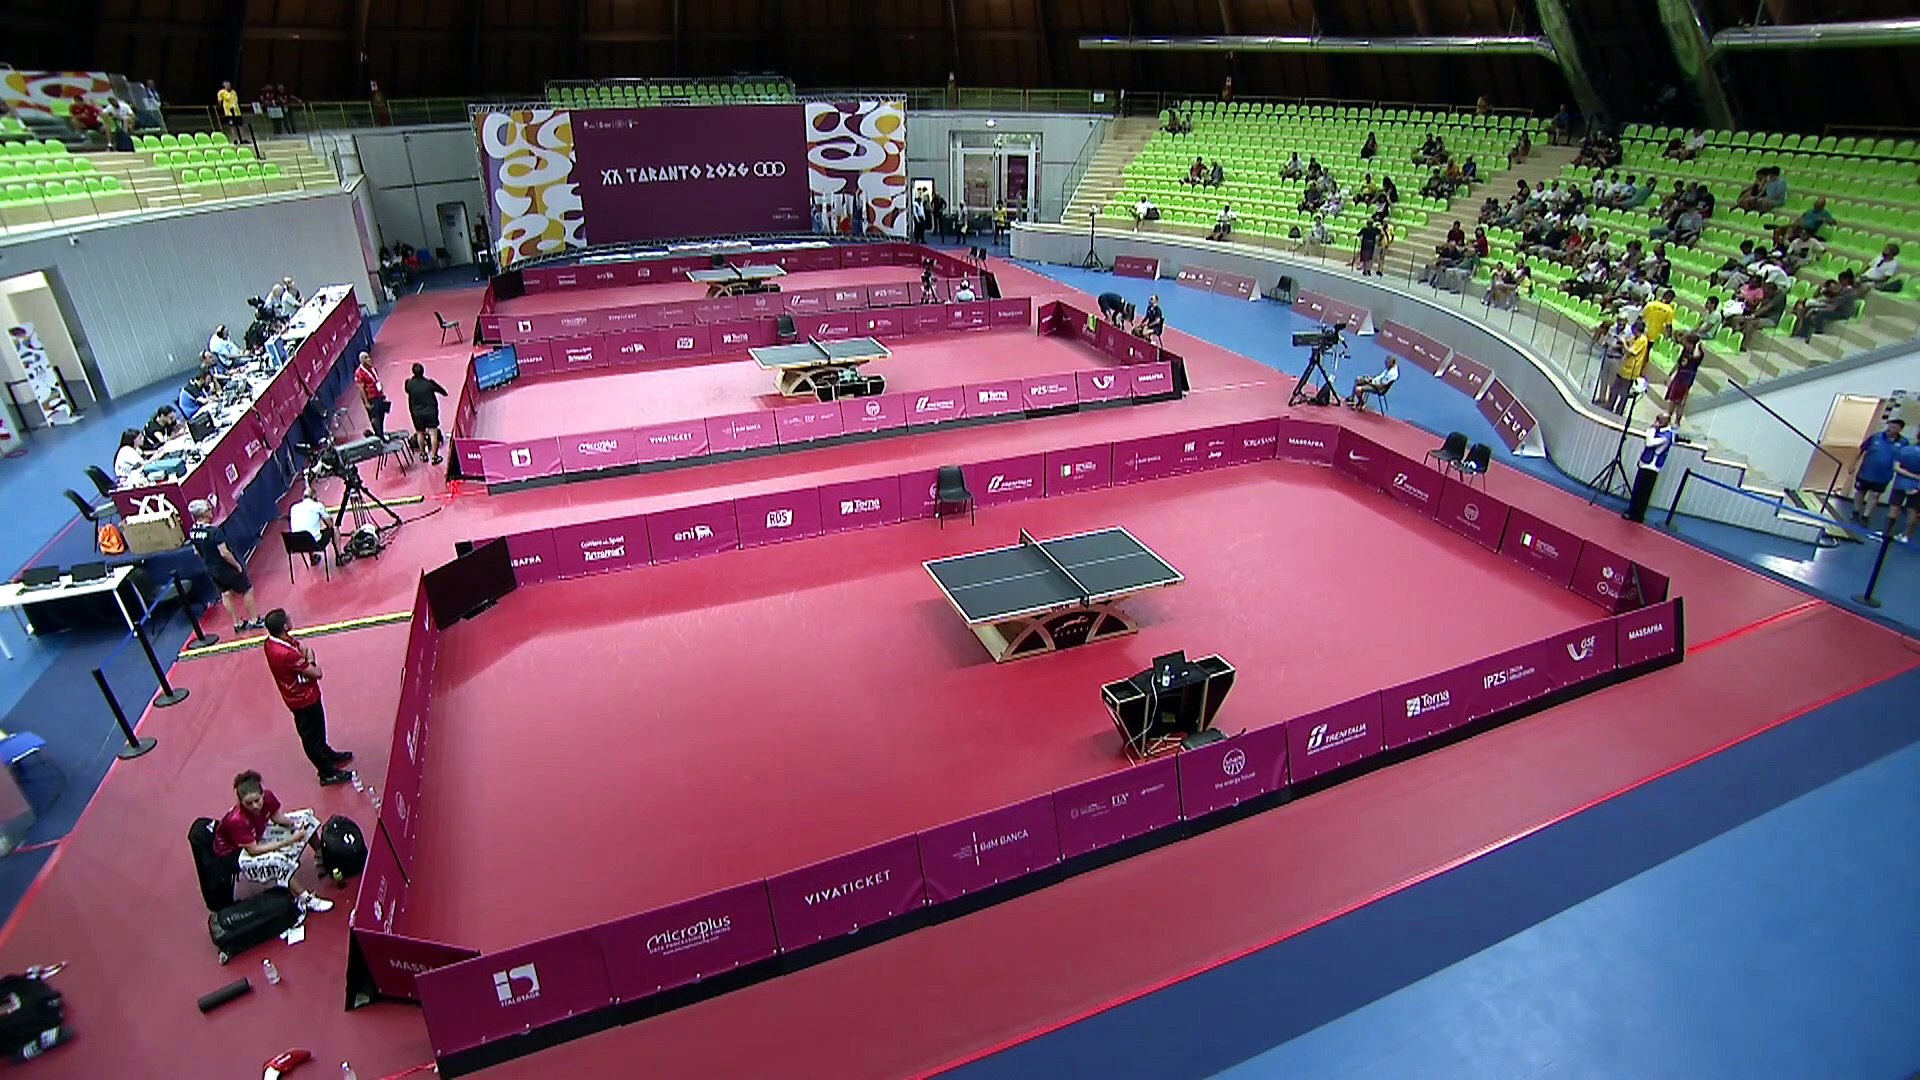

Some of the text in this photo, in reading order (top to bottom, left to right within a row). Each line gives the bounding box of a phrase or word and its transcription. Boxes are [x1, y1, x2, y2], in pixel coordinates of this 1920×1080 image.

[626, 164, 702, 183] TARANTO
[705, 162, 749, 179] 2026
[1288, 437, 1324, 448] MASSAFRA
[769, 510, 788, 524] RDS
[674, 528, 695, 541] eni
[1628, 623, 1664, 640] MASSAFRA
[1483, 671, 1507, 689] IPZS
[1421, 689, 1450, 707] Terna
[1325, 722, 1367, 743] TRENITALIA
[1000, 828, 1029, 845] BANCA
[804, 869, 890, 906] VIVATICKET
[646, 915, 731, 952] microplus
